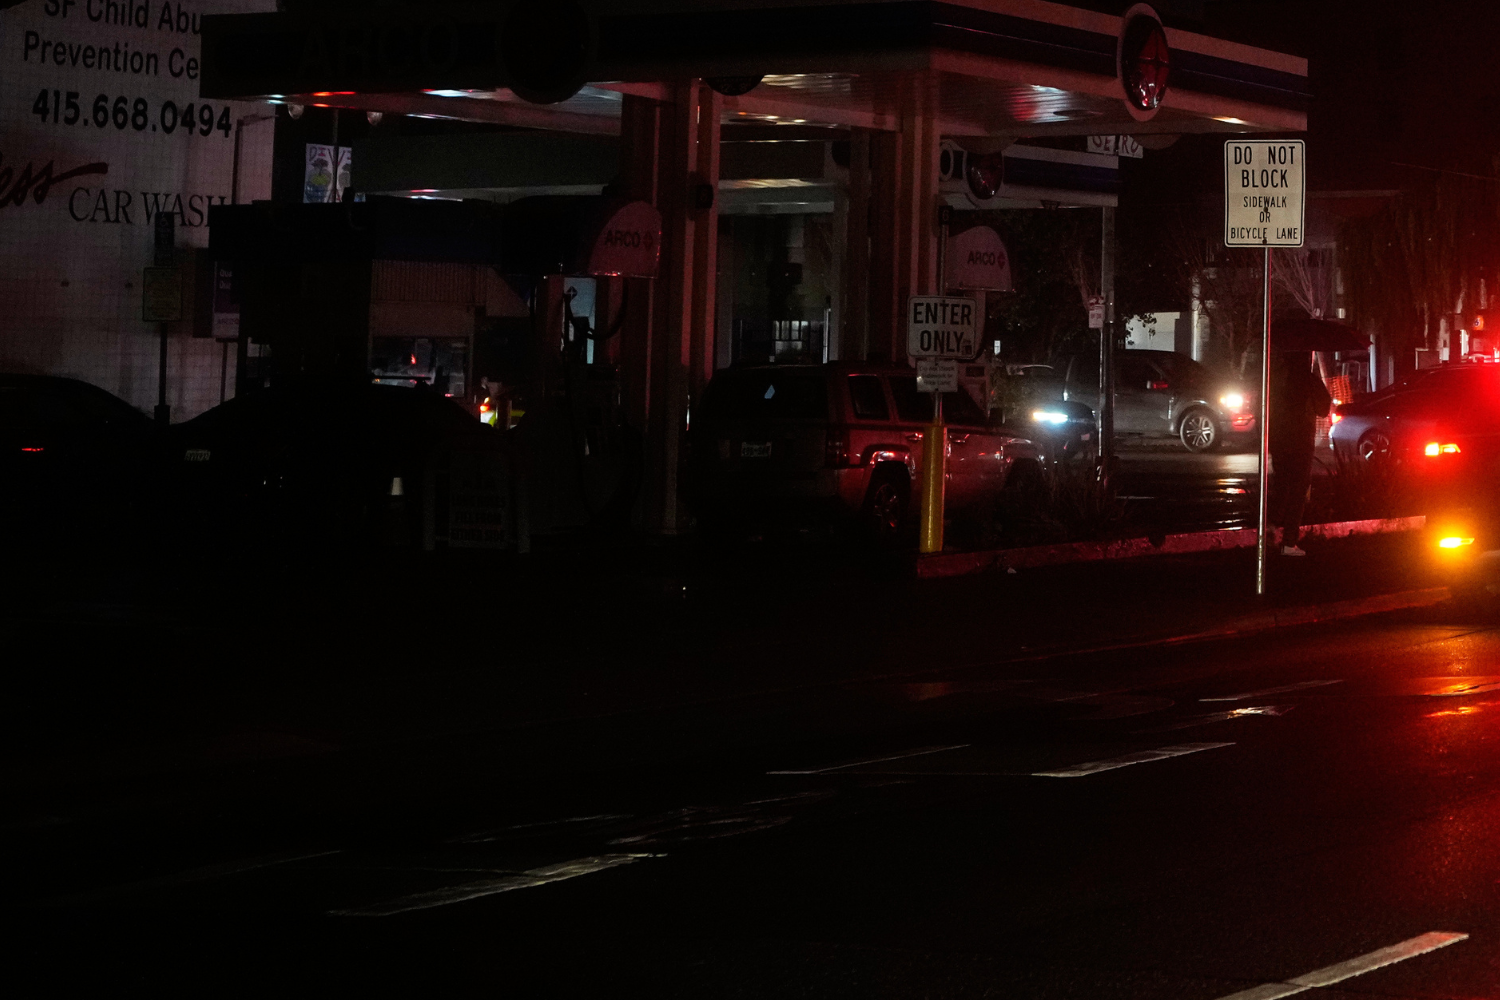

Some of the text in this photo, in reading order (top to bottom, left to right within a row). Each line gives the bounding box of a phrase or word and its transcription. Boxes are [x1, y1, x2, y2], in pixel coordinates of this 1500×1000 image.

[23, 31, 159, 76] Prevention
[295, 15, 460, 79] ARCO
[33, 89, 231, 138] 415.668.0494
[1234, 146, 1295, 165] DO NOT
[1242, 169, 1288, 188] BLOCK
[68, 187, 133, 224] CAR
[1243, 196, 1287, 208] SIDEWALK
[1259, 212, 1271, 223] OR
[604, 230, 641, 247] ARCO
[1231, 228, 1298, 239] BICYCLE LANE
[967, 251, 995, 267] ARCO
[914, 302, 972, 326] ENTER
[920, 330, 964, 354] ONLY
